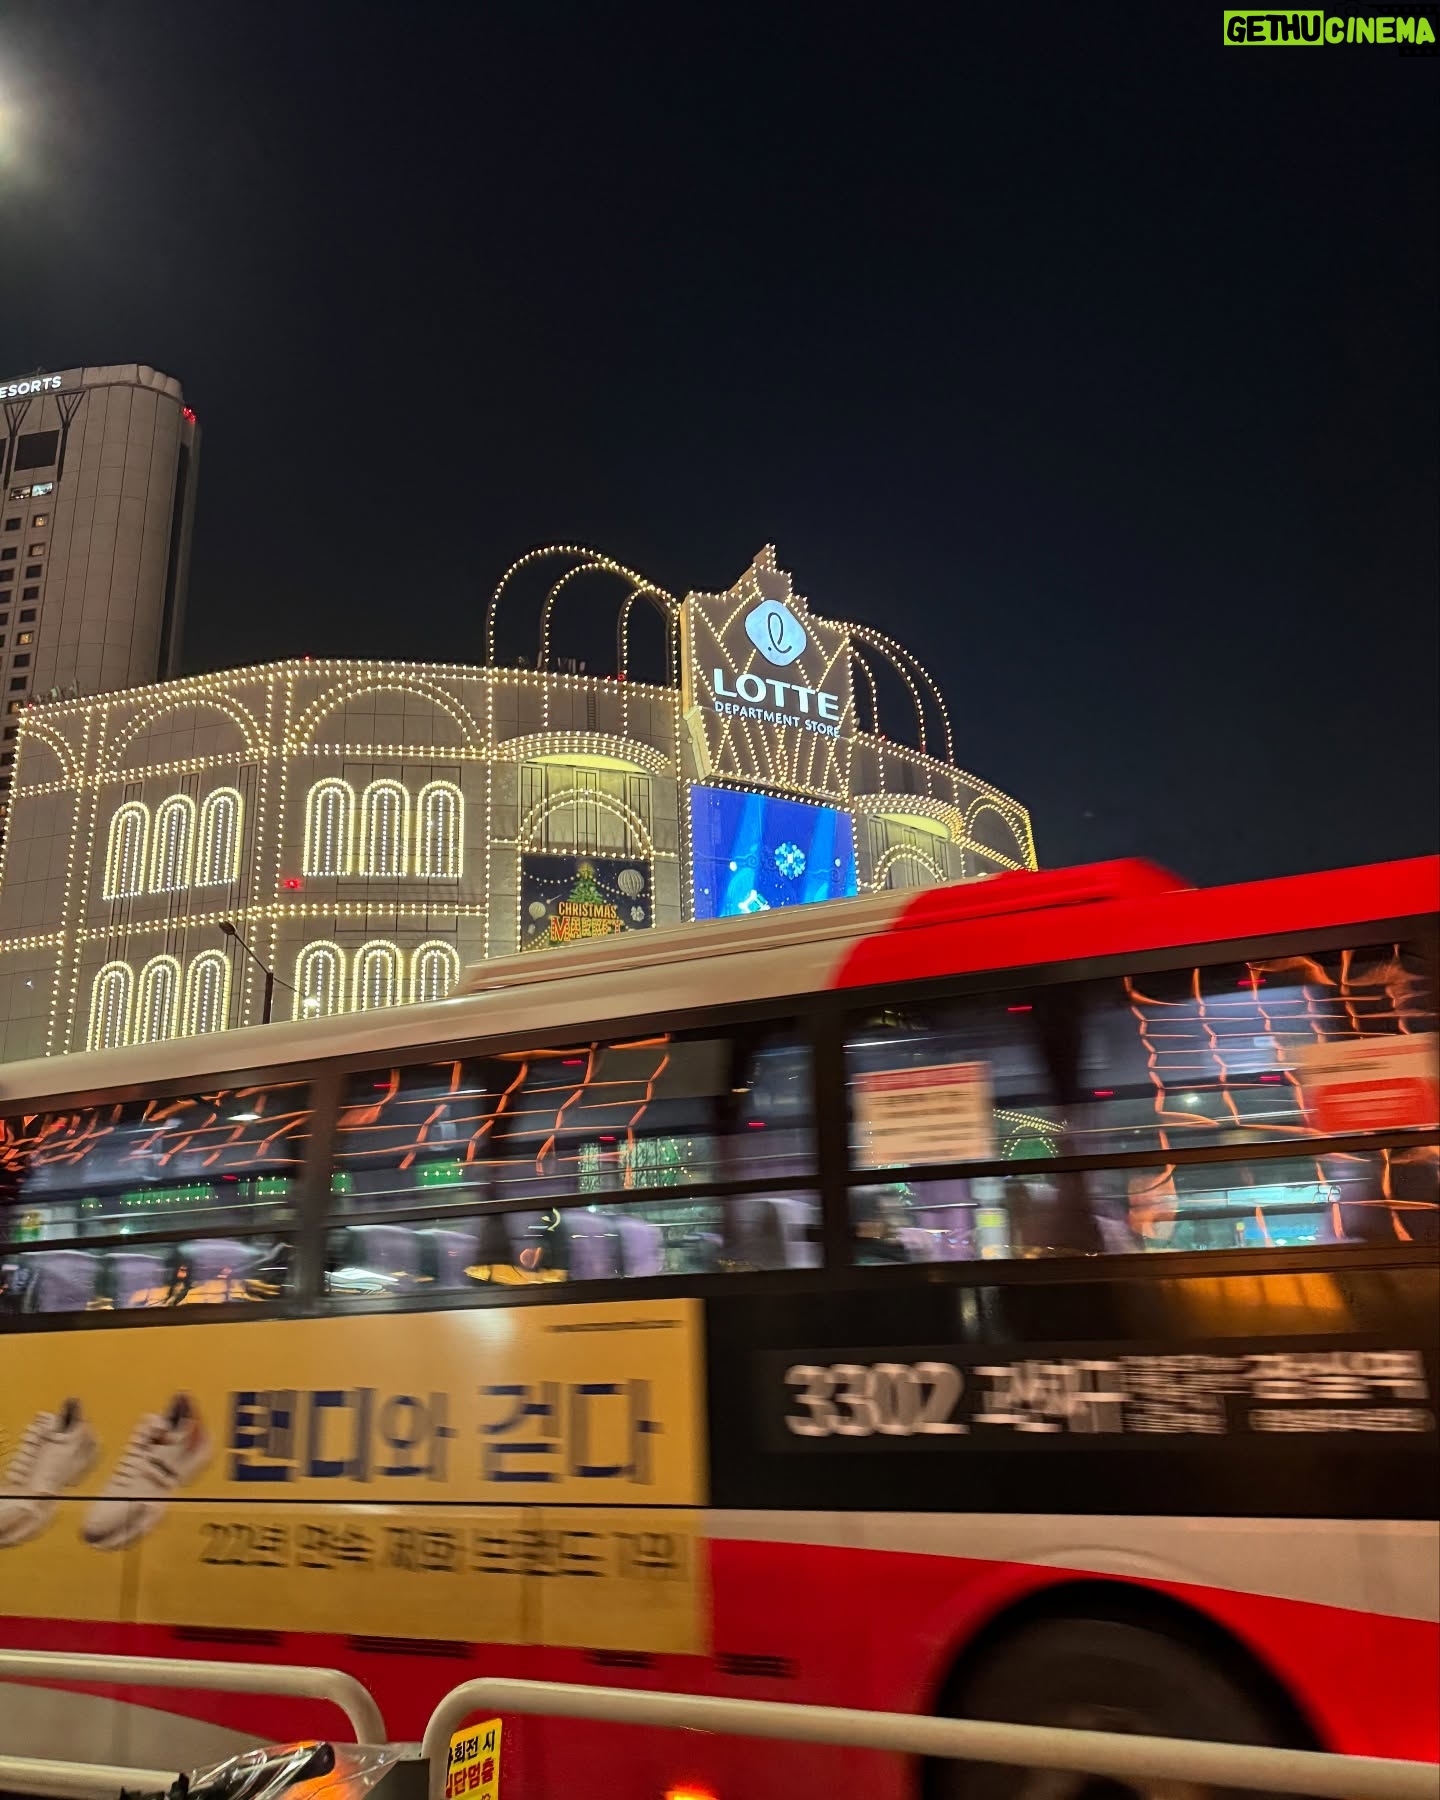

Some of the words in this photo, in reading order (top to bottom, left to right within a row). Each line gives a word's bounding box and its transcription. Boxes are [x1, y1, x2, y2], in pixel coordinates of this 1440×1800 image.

[713, 668, 840, 721] LOTTE
[714, 700, 800, 728] DEPARTMENT
[804, 719, 841, 738] STORE
[550, 915, 622, 942] MARKET
[558, 901, 618, 919] CHRISTMAS
[785, 1361, 969, 1437] 3302
[479, 1378, 661, 1485] 걷다
[199, 1521, 288, 1570] 22년
[482, 1729, 495, 1752] 시
